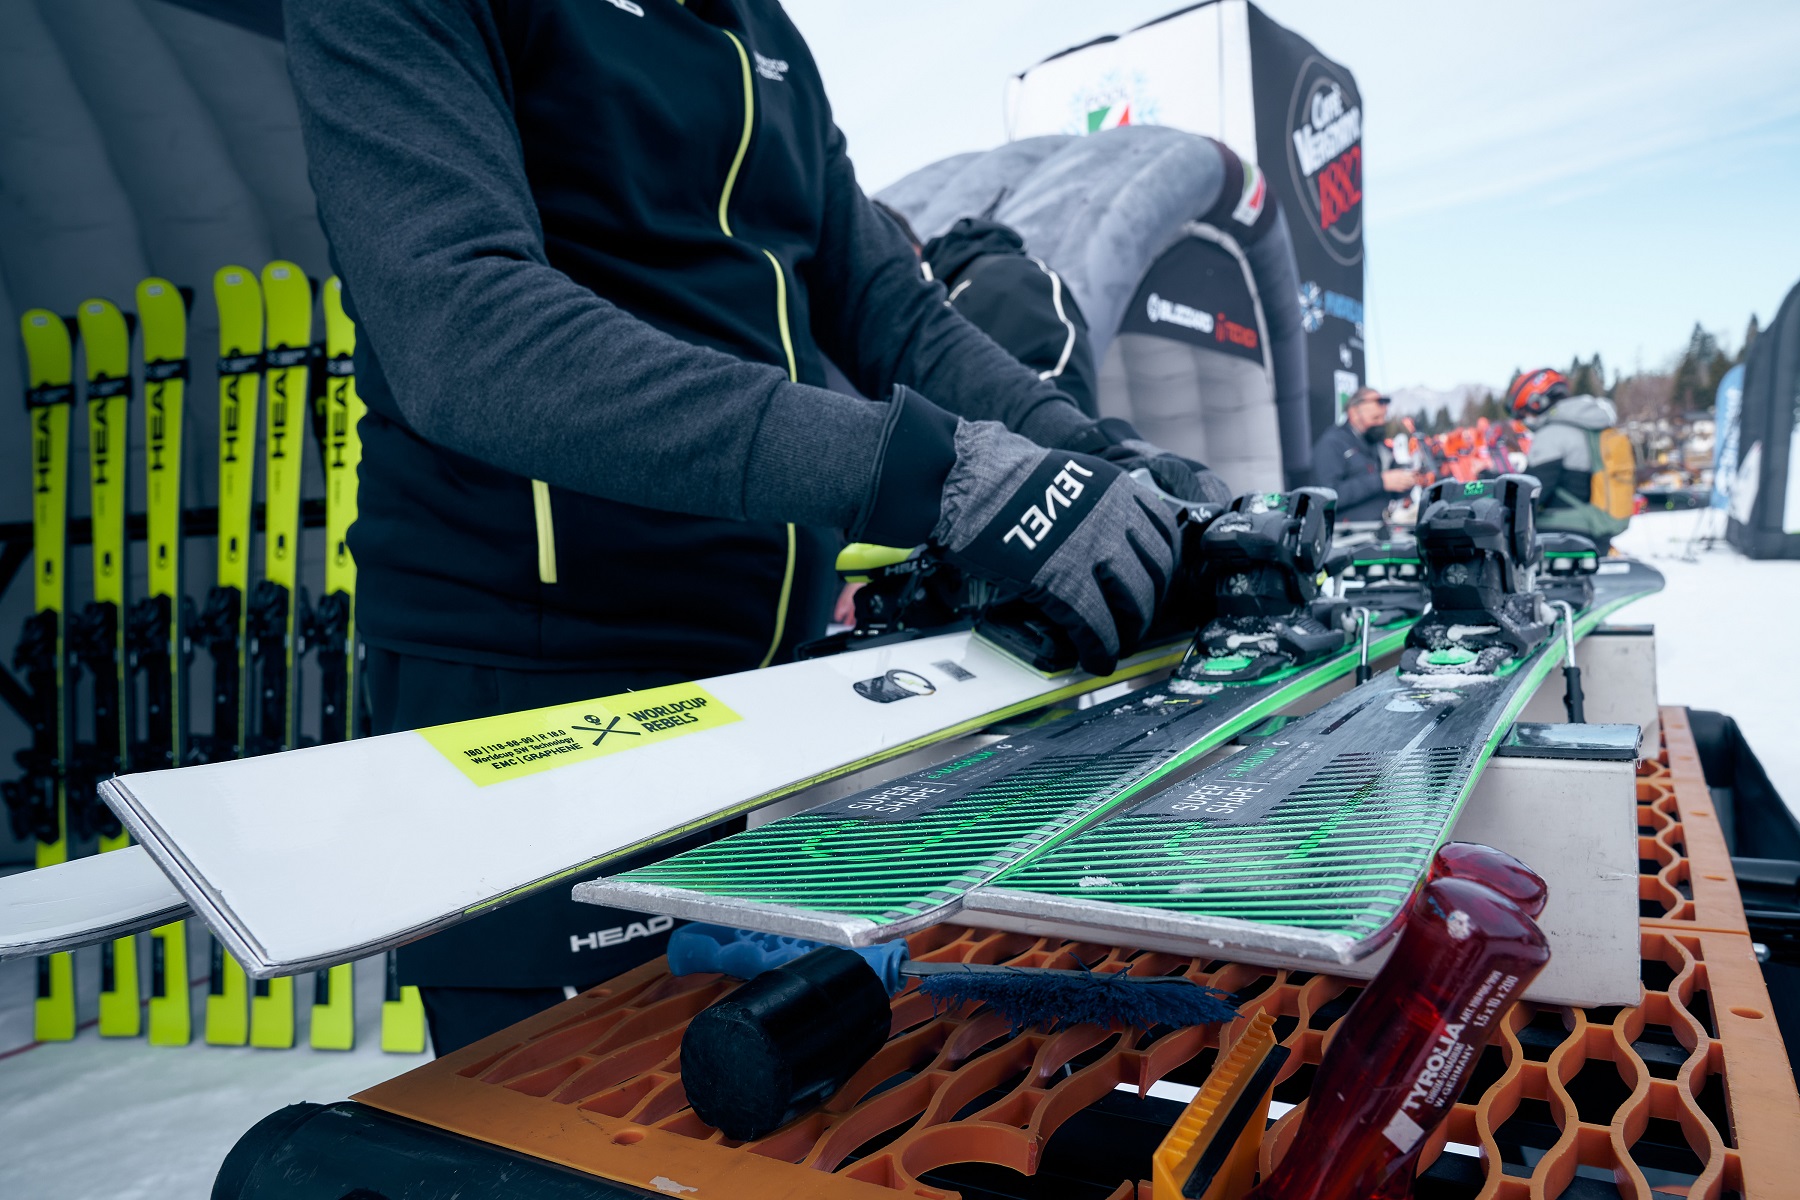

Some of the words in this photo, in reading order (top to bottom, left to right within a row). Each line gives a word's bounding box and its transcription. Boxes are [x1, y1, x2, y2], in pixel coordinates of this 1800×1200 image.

[1002, 459, 1094, 551] LEVEL
[627, 697, 707, 722] WORLDCUP
[641, 712, 699, 732] REBELS
[471, 751, 514, 764] Worldcup
[528, 737, 575, 751] Technology
[491, 758, 518, 770] EMC
[522, 742, 584, 762] GRAPHENE
[847, 785, 919, 810] SUPER
[875, 787, 947, 813] SHAPE
[1171, 784, 1231, 811] SUPER
[1205, 786, 1264, 814] SHAPE
[570, 915, 674, 953] HEAD
[1401, 1023, 1466, 1110] TYROLIA
